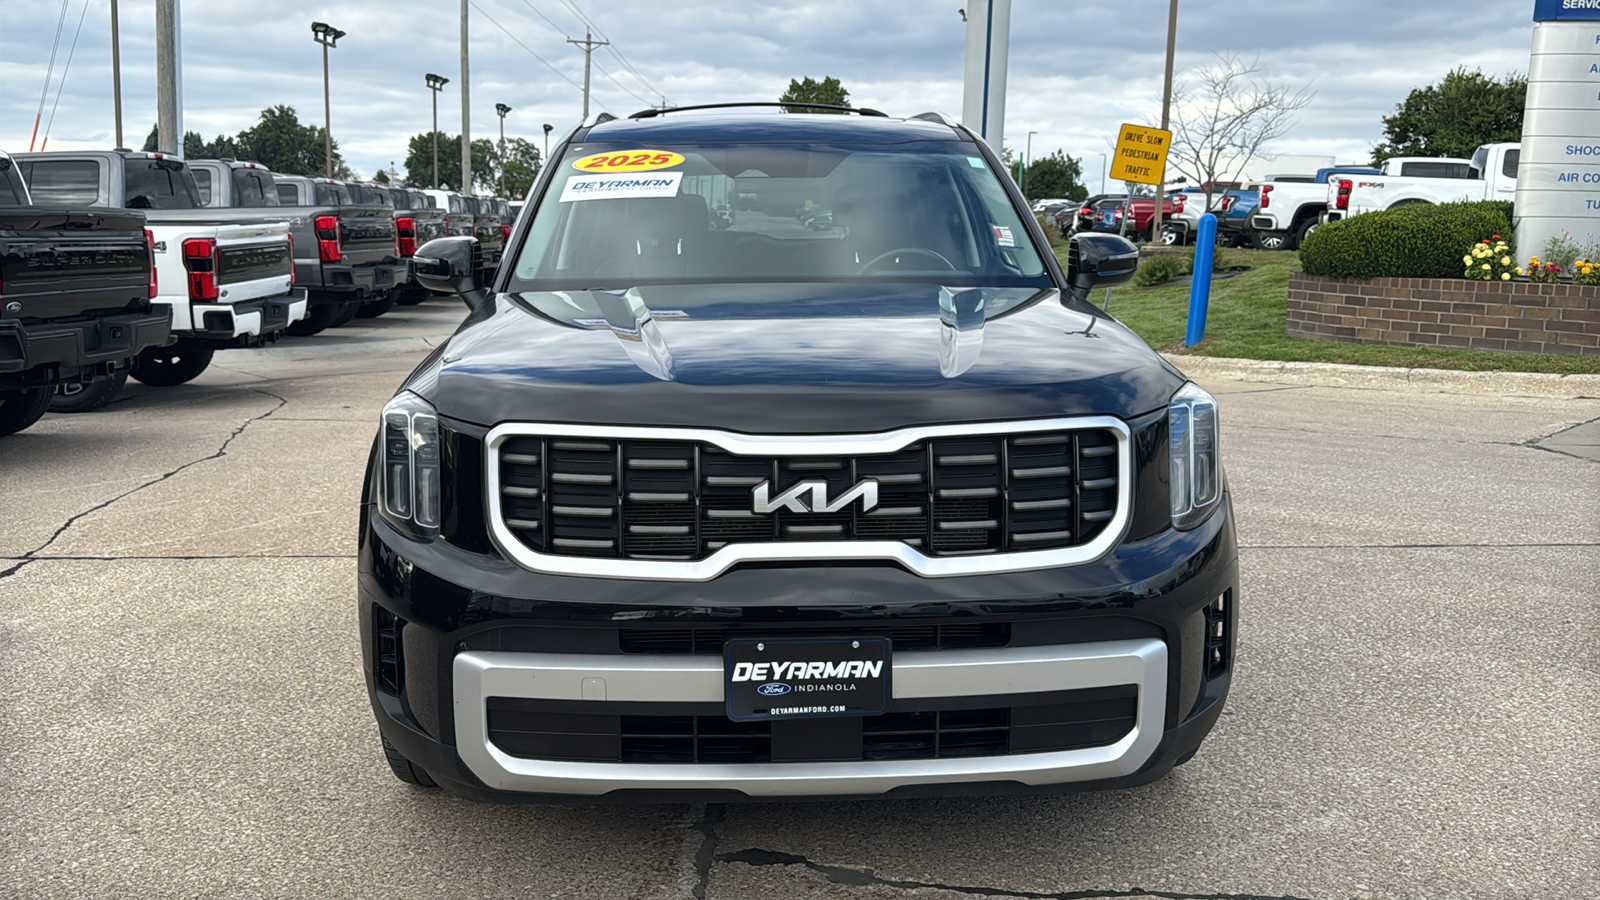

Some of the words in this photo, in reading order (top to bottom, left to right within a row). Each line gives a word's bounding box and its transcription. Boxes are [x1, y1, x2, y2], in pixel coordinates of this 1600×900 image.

[1125, 132, 1144, 143] DRIVE
[1146, 135, 1163, 145] SLOW
[1121, 148, 1159, 161] PEDESTRIAN
[584, 154, 673, 168] 2025
[1125, 164, 1150, 176] TRAFFIC
[1558, 172, 1579, 182] AIR
[572, 180, 674, 190] DEYARMAN
[753, 480, 878, 513] KIA
[732, 660, 884, 682] DEYARMAN
[764, 684, 784, 694] Ford
[794, 684, 856, 692] INDIANOLA
[770, 706, 846, 714] DEYARMANFORD.COM
